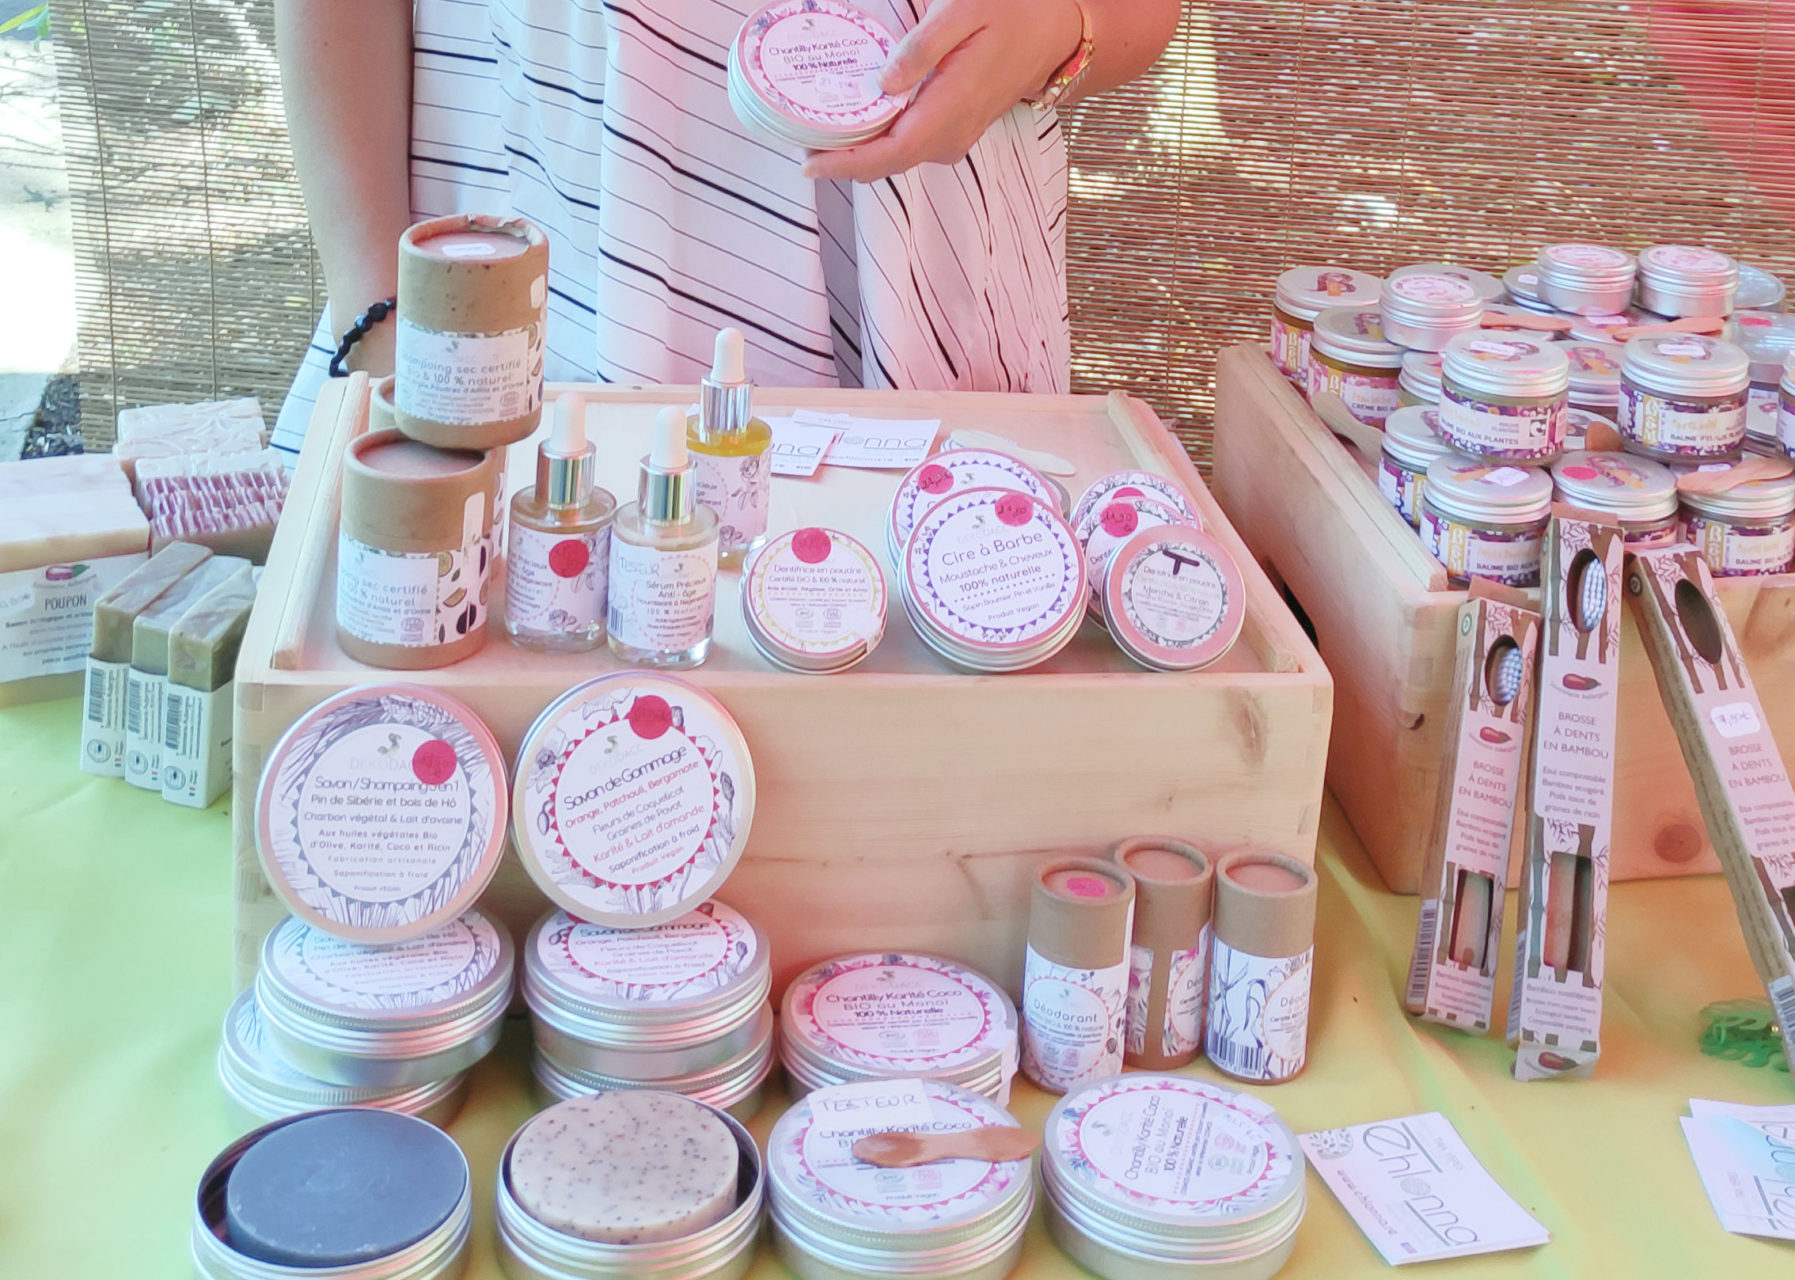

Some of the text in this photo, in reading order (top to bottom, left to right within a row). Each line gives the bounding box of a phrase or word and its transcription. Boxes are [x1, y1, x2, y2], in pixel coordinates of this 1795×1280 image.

[769, 42, 811, 56] Chantilly
[842, 38, 867, 47] Coco
[784, 55, 804, 64] BIO
[808, 54, 822, 62] au
[481, 360, 521, 373] certifié
[434, 374, 449, 384] 100
[468, 374, 512, 386] naturel
[1468, 430, 1481, 440] AUX
[1484, 435, 1519, 445] PLANTES
[942, 532, 1043, 566] Cire à Barbe
[774, 564, 815, 573] Dentifrice
[830, 567, 861, 575] poudre
[939, 550, 1053, 584] Moustache & Cheveux
[1477, 563, 1504, 571] BAUME
[646, 578, 706, 590] Sérum Précieux
[960, 565, 1041, 593] 100% naturelle
[383, 584, 428, 595] certifié
[1143, 585, 1209, 607] Menthe & Citron
[45, 594, 86, 610] POUPON
[371, 595, 415, 606] naturel
[1558, 711, 1596, 726] BROSSE
[1565, 727, 1600, 742] DENTS
[1543, 741, 1609, 760] EN BAMBOU
[1728, 743, 1762, 756] BROSSE
[1473, 761, 1505, 777] BROSSE
[1741, 758, 1773, 770] DENTS
[564, 745, 687, 811] Savon de Gommage
[1477, 776, 1507, 792] DENTS
[1728, 773, 1785, 789] EN BAMBOU
[311, 795, 327, 804] Pin
[330, 795, 343, 805] de
[347, 795, 384, 806] Sibérie
[386, 797, 397, 806] et
[400, 797, 421, 807] bois
[425, 797, 438, 808] de
[565, 761, 699, 829] Orange, Patchouli, Bergamote
[1458, 786, 1512, 808] EN BAMBOU
[592, 786, 685, 835] Fleurs de Coquelicot
[304, 812, 463, 825] Charbon végétal & Lait d'avoine
[607, 800, 683, 842] Graines de Pavot
[319, 829, 438, 840] Aux huiles végétales Bio
[593, 804, 705, 863] Karité & Lait d'amande
[672, 835, 678, 843] à
[679, 825, 700, 840] froid
[387, 843, 410, 851] Coco
[427, 844, 450, 852] Ricin
[328, 856, 384, 864] Fabrication
[334, 870, 397, 878] Saponification
[408, 871, 428, 879] froid
[826, 989, 962, 1004] Chantilly Karité Coco
[844, 1001, 872, 1011] BIO
[877, 1001, 897, 1010] au
[854, 1007, 943, 1018] 100 % Naturelle
[1034, 998, 1097, 1023] Déodorant
[818, 1094, 921, 1113] TESTEUR
[886, 1122, 930, 1133] Karité
[932, 1121, 972, 1131] Coco
